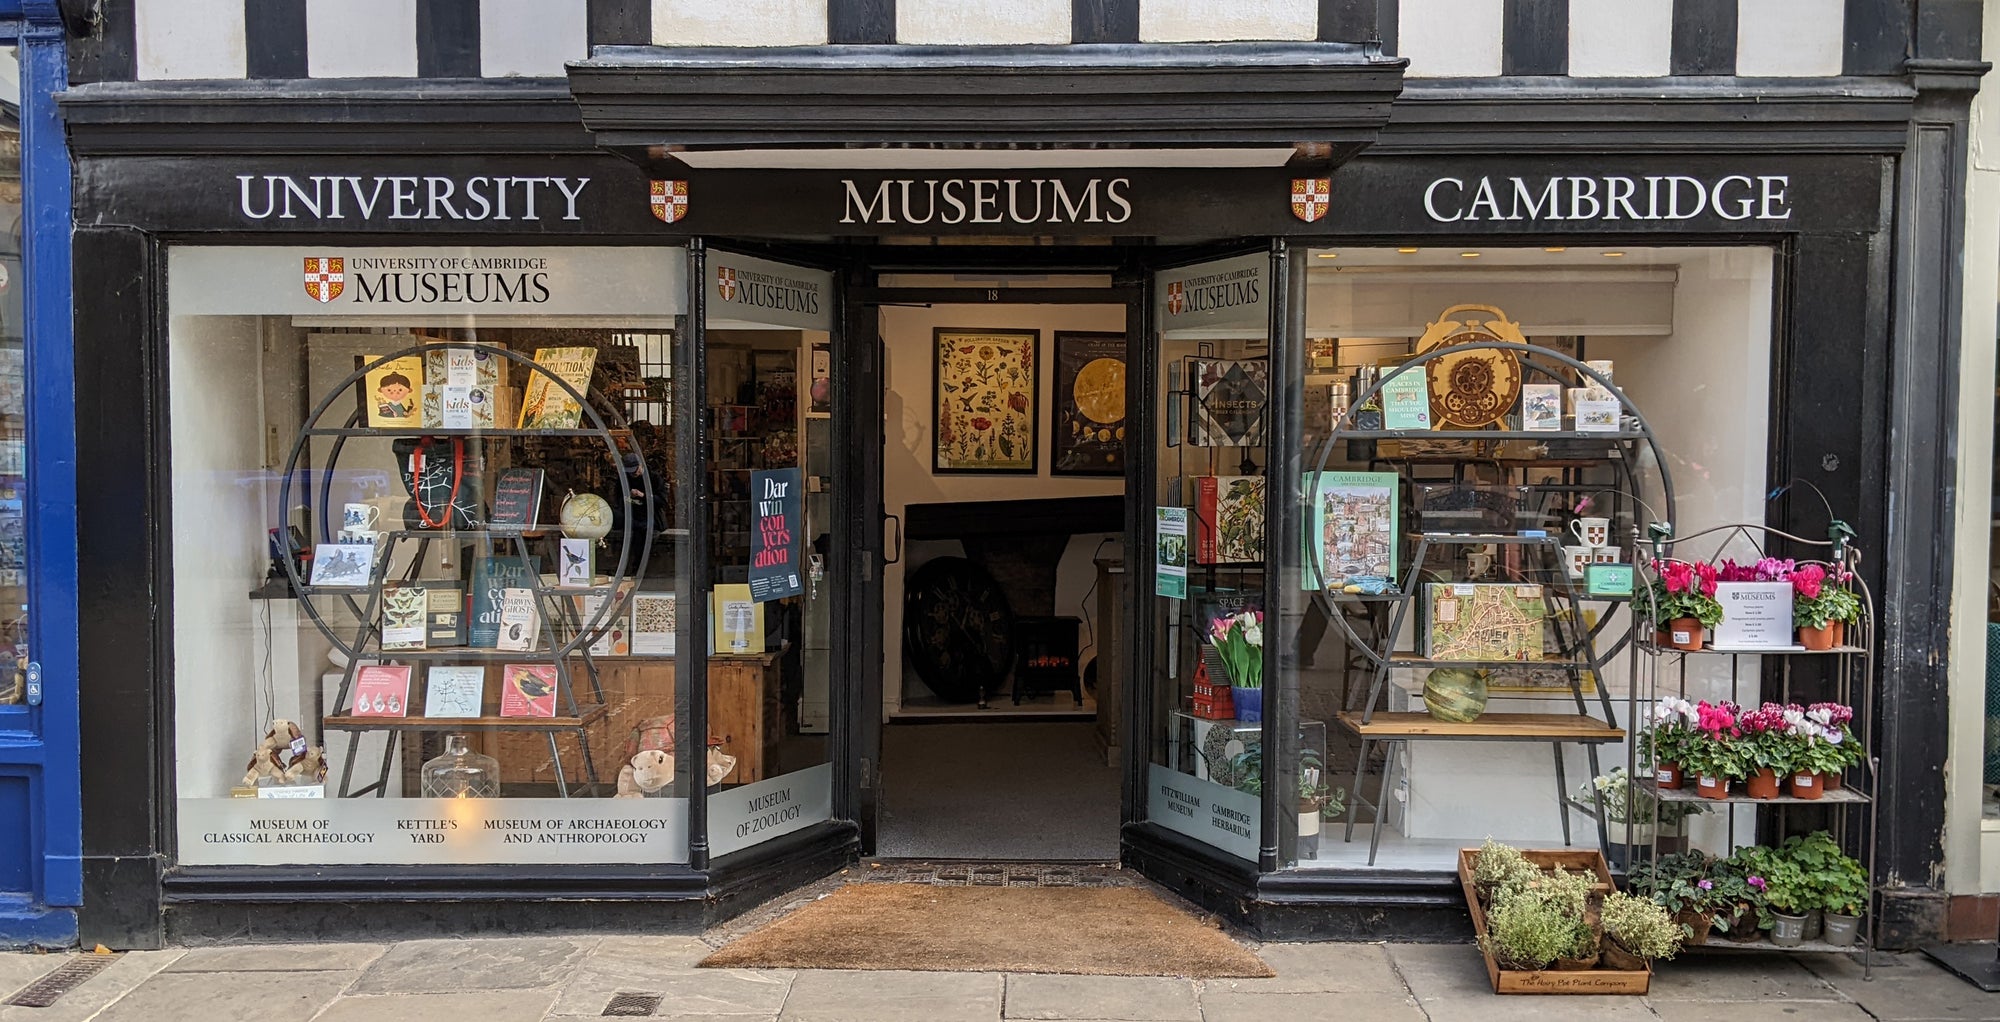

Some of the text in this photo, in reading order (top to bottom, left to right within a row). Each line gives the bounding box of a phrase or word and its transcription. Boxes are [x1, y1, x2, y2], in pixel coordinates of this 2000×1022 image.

[236, 175, 591, 220] UNIVERSITY
[839, 178, 1132, 224] MUSEUMS
[1423, 175, 1792, 222] CAMBRIDGE
[352, 257, 547, 270] UNIVERSITY OF CAMBRIDGE
[737, 270, 818, 291] UNIVERSITY OF CAMBRIDGE
[1184, 267, 1259, 288] UNIVERSITY OF CAMBRIDGE
[352, 273, 550, 303] MUSEUMS
[738, 280, 818, 315] MUSEUMS
[987, 289, 999, 301] 18
[1184, 278, 1259, 313] MUSEUMS
[451, 355, 474, 367] kids
[446, 398, 469, 409] kids
[764, 477, 788, 500] Dar
[759, 497, 783, 517] win
[760, 515, 785, 532] con
[755, 546, 788, 568] ation
[494, 562, 525, 577] Dar
[504, 605, 535, 614] GHOSTS
[1219, 597, 1245, 608] SPACE
[748, 788, 791, 814] MUSEUM
[1161, 785, 1200, 807] FITZWILLIAM
[1167, 800, 1193, 818] MUSEUM
[1211, 803, 1251, 825] CAMBRIDGE
[250, 820, 330, 830] MUSEUM OF
[397, 820, 458, 830] KETTLE'S
[484, 819, 667, 830] MUSEUM OF ARCHAEOLOGY
[737, 804, 801, 839] OF ZOOLOGY
[1212, 817, 1251, 839] HERBARIUM
[203, 833, 375, 843] CLASSICAL ARCHAEOLOGY
[410, 833, 445, 844] YARD
[504, 833, 648, 843] AND ANTHROPOLOGY
[1537, 979, 1556, 987] Hairy
[1594, 979, 1628, 987] Company
